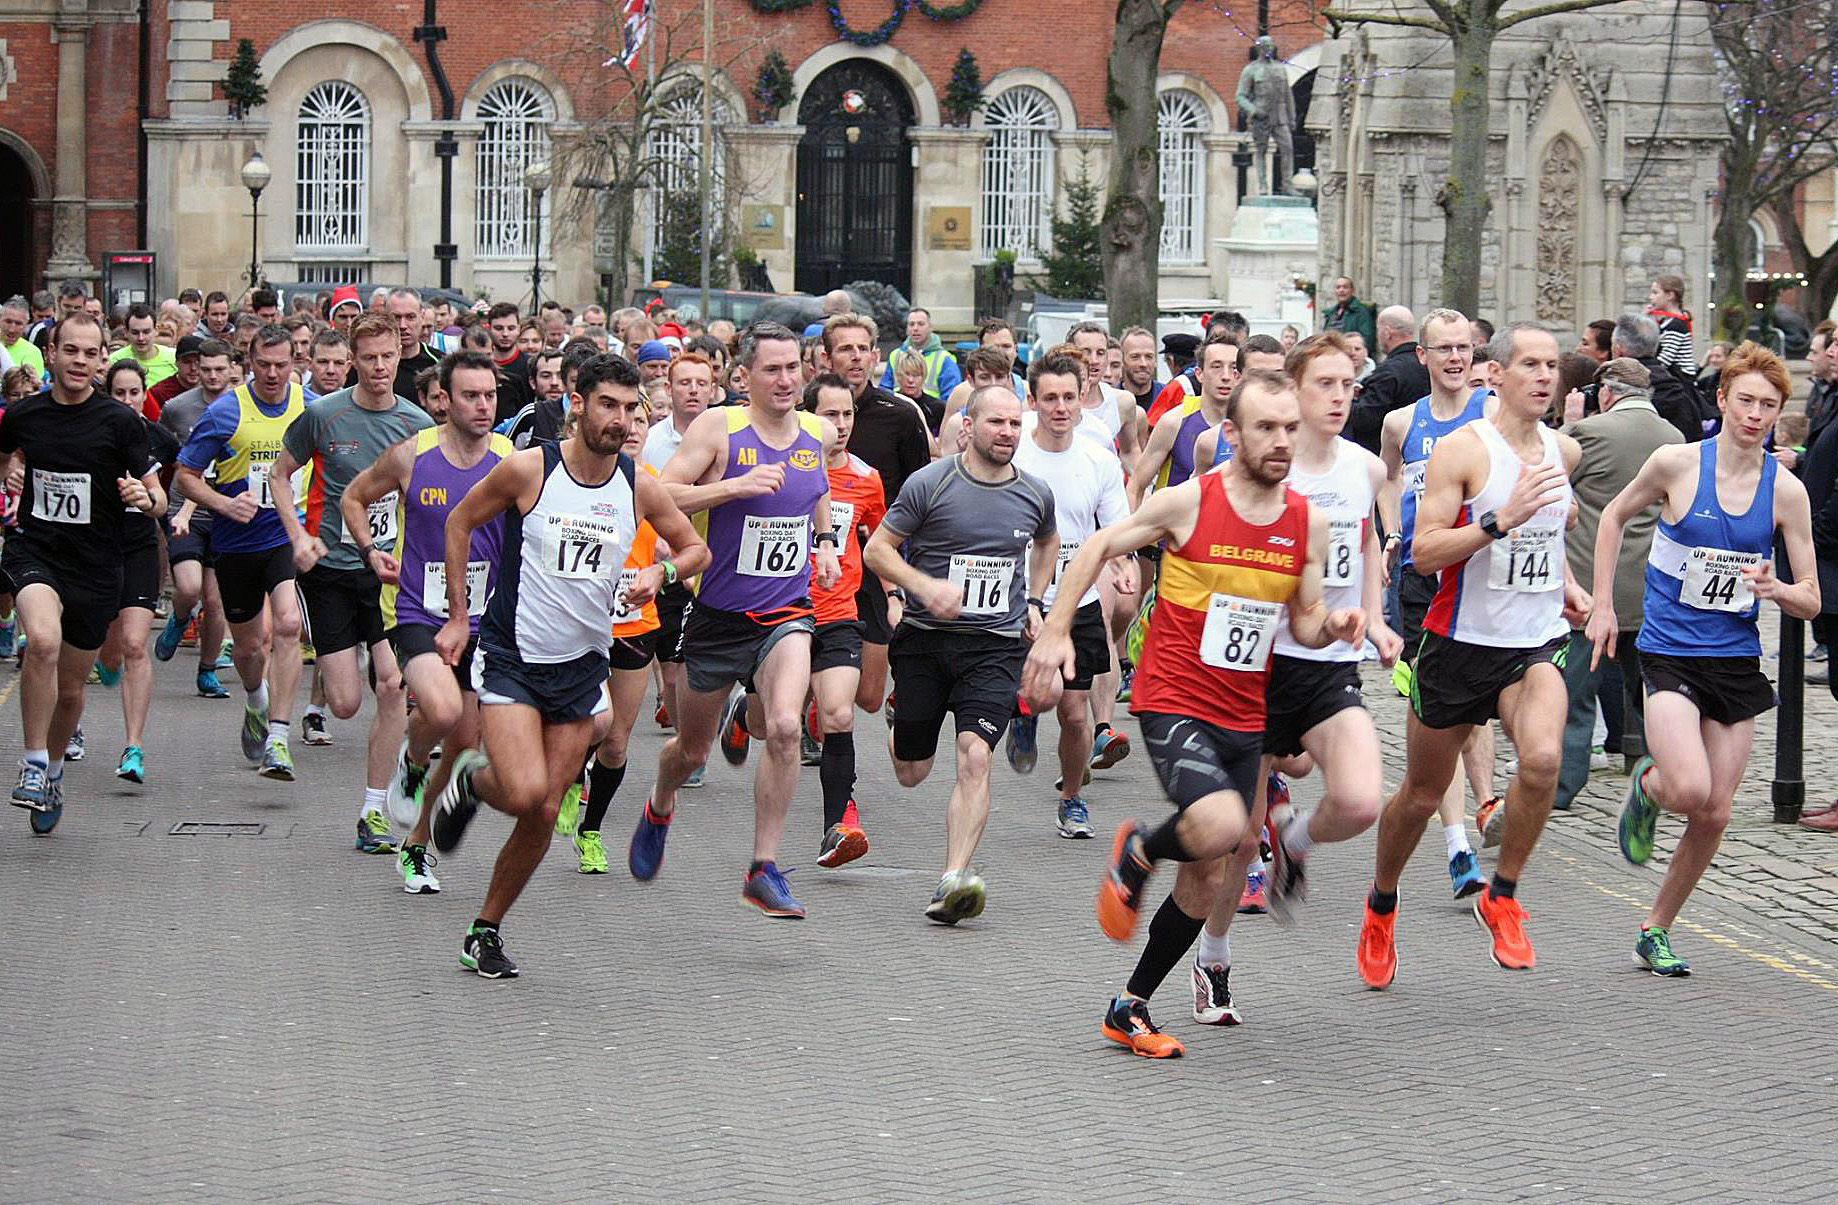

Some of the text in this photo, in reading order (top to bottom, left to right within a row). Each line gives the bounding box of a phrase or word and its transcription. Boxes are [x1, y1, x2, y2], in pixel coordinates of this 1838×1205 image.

[737, 448, 757, 465] AH
[44, 491, 80, 518] 170
[420, 488, 447, 505] CPN
[830, 505, 850, 513] NING
[369, 512, 389, 538] 68
[549, 516, 562, 525] UP
[572, 519, 614, 534] RUNNING
[562, 527, 586, 536] BOXING
[748, 520, 761, 529] UP
[769, 520, 805, 529] RUNNING
[558, 539, 603, 573] 174
[755, 541, 799, 572] 162
[954, 558, 966, 566] UP
[975, 560, 1012, 568] RUNNING
[1209, 544, 1295, 568] BELGRAVE
[1693, 550, 1707, 559] UP
[1716, 554, 1757, 564] RUNNING
[1706, 562, 1730, 570] BOXING
[1507, 552, 1549, 586] 144
[962, 579, 1001, 608] 116
[1702, 575, 1737, 604] 44
[1225, 627, 1260, 664] 82
